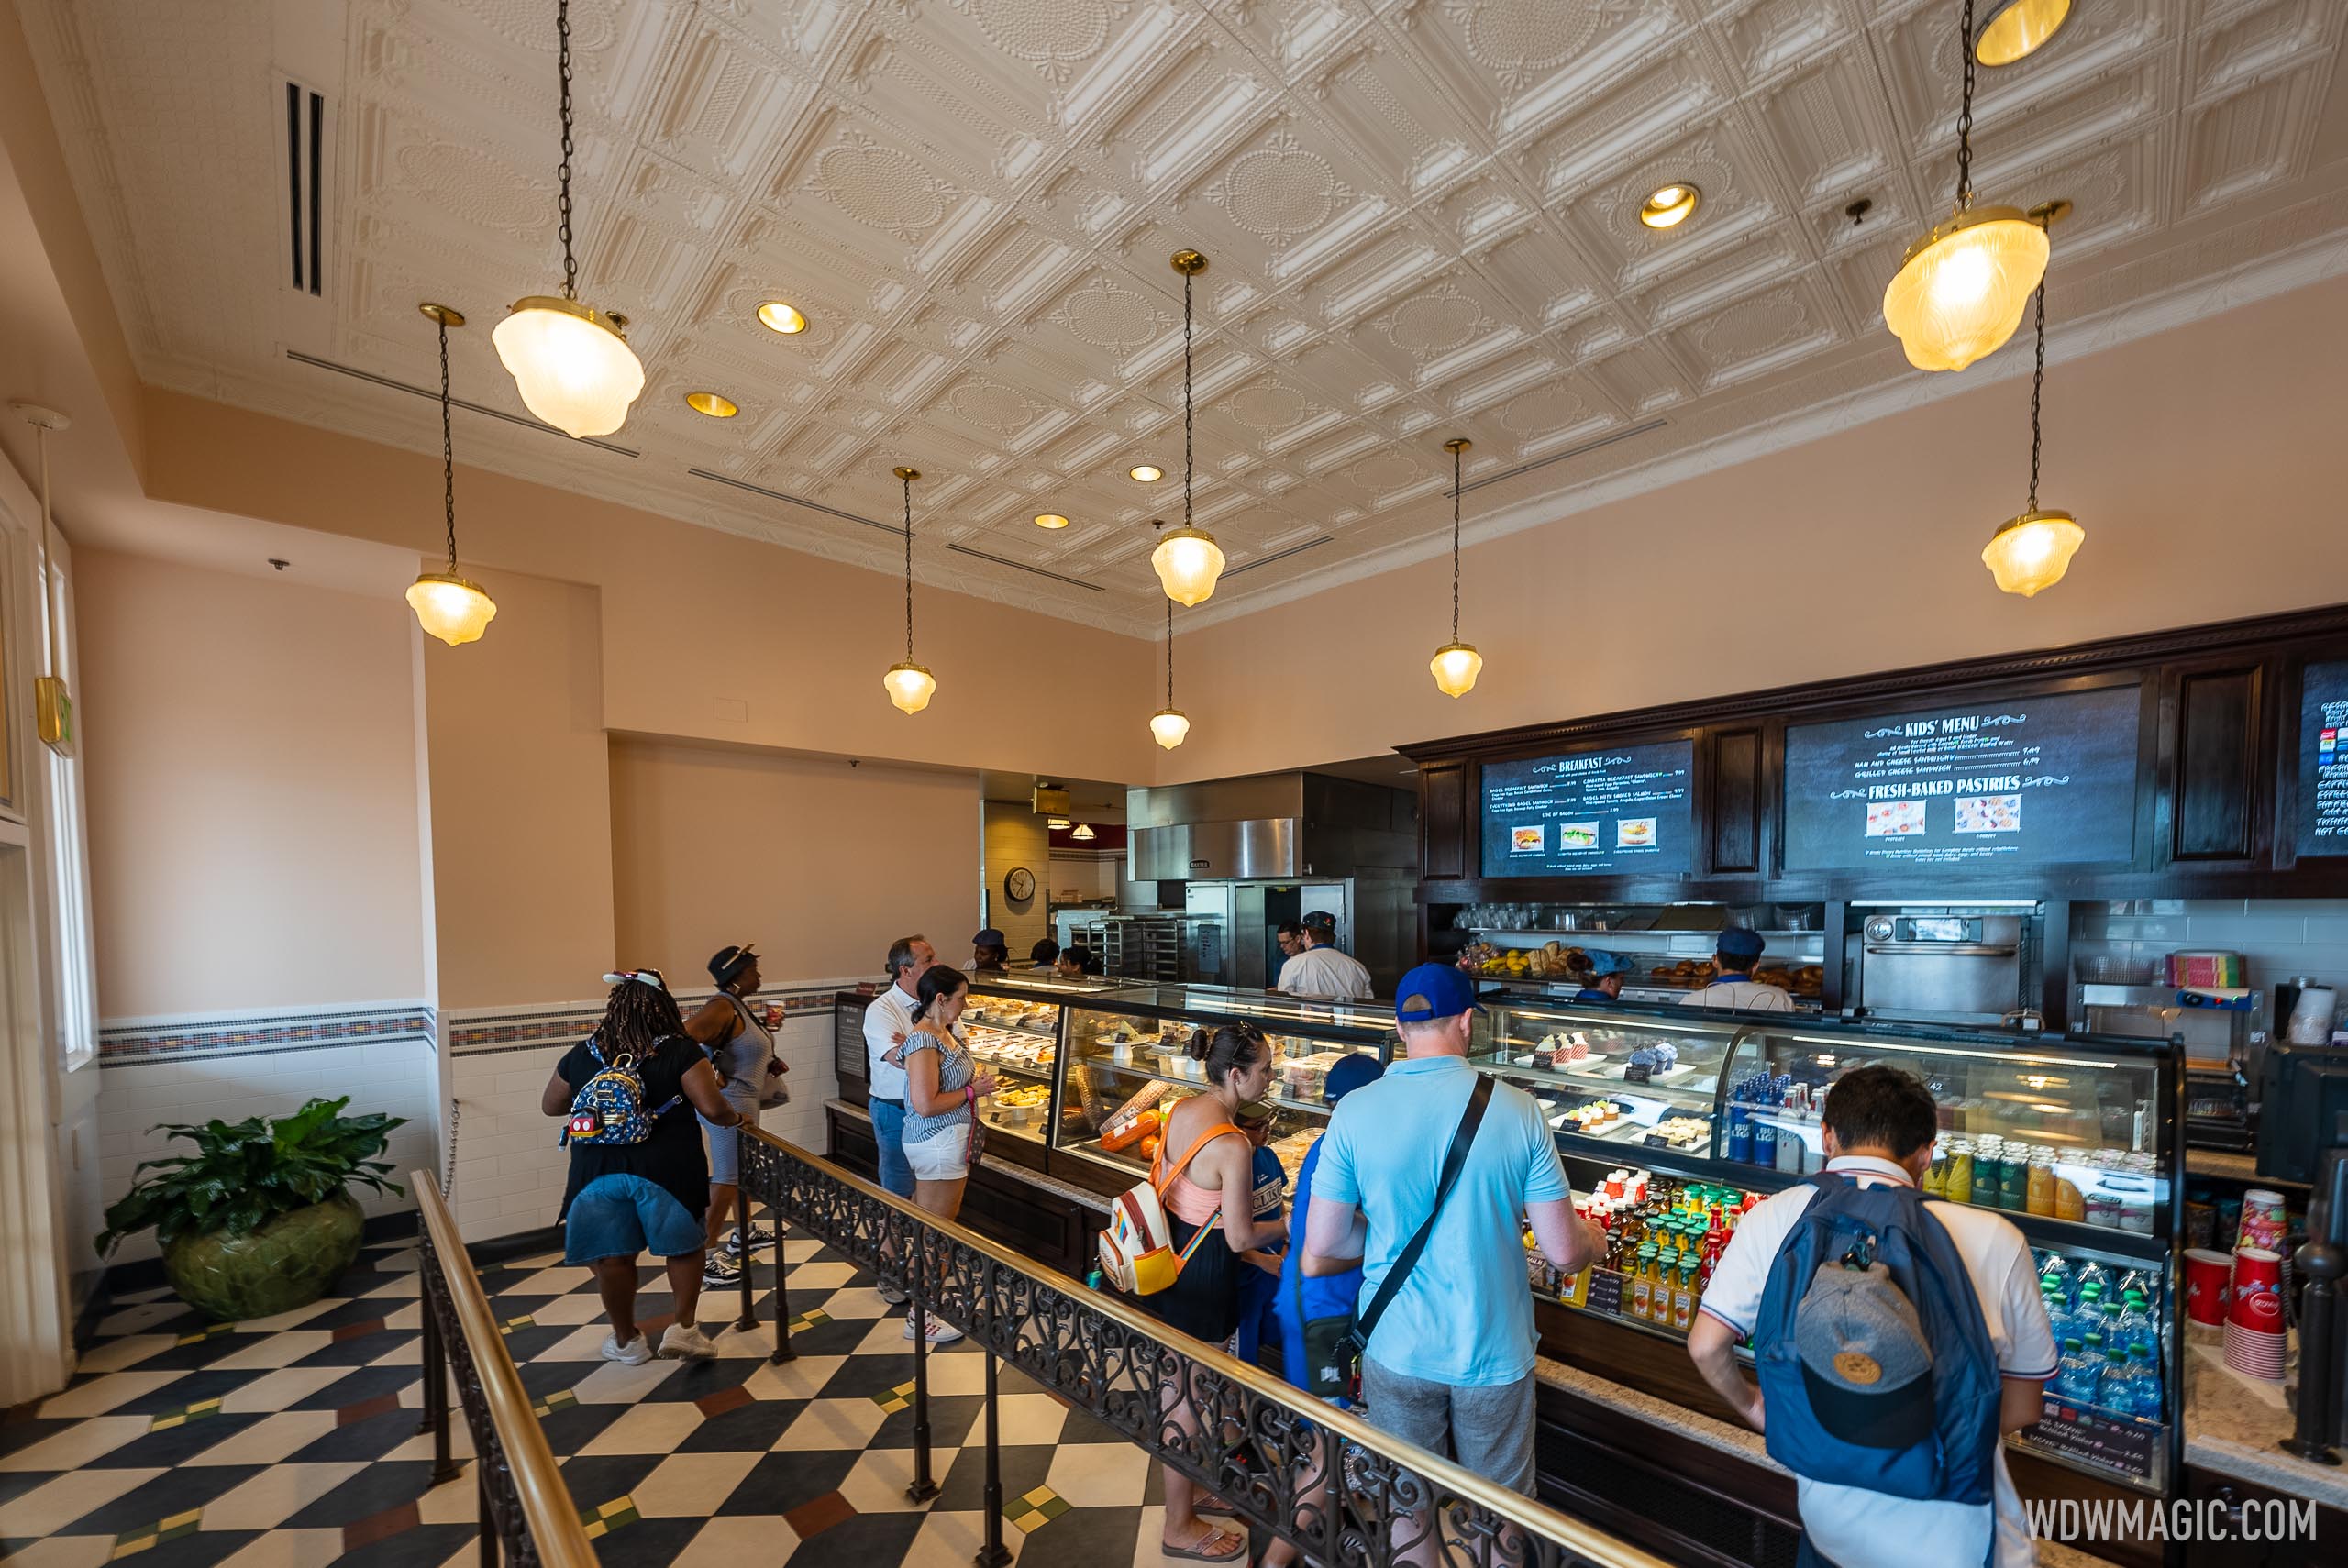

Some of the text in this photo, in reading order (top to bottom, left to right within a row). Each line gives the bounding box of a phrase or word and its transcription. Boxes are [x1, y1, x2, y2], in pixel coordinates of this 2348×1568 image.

[1905, 716, 1980, 737] KIDS' MENU
[1559, 757, 1603, 772] BREAKFAST
[1869, 775, 2020, 799] FRESH-BAKED PASTRIES
